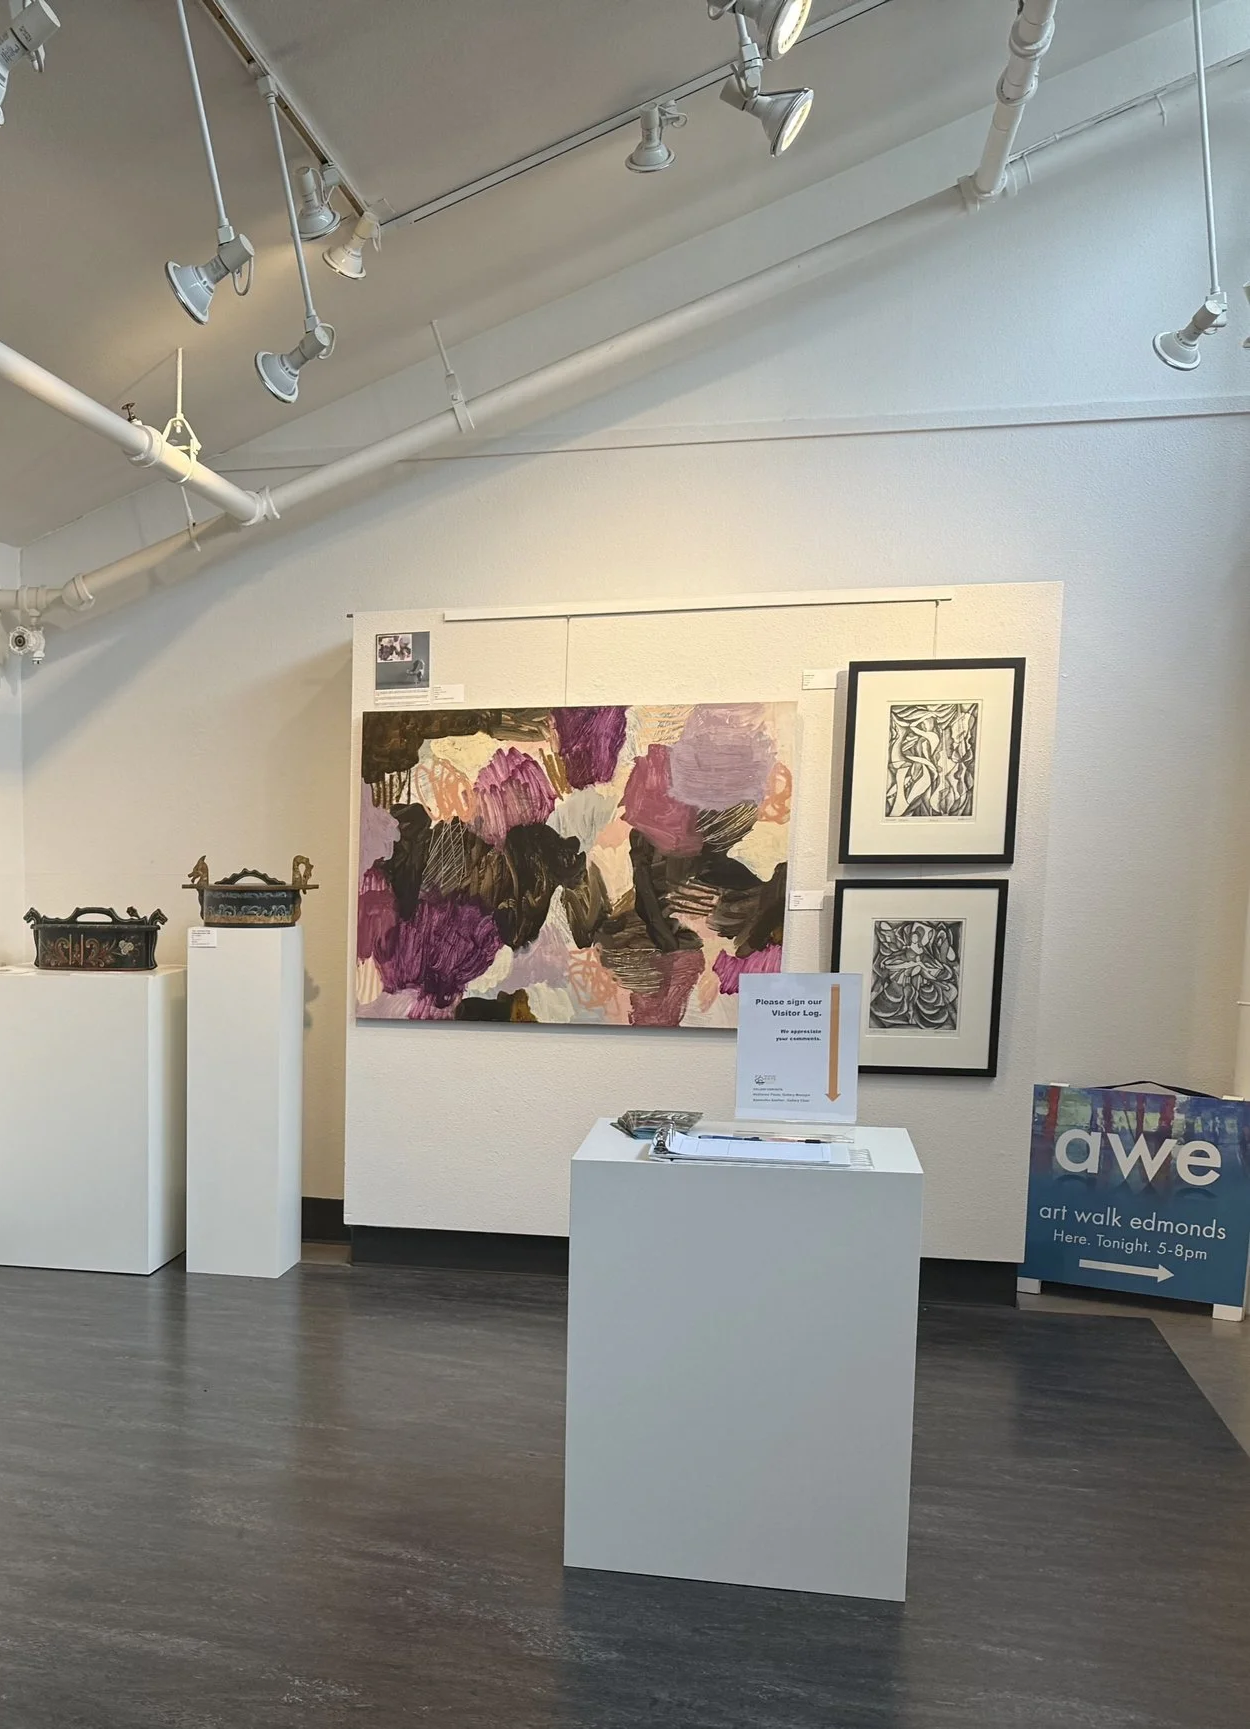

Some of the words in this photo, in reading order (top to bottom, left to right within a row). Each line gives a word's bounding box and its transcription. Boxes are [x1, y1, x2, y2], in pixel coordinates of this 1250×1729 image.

[786, 998, 805, 1006] sign
[803, 1010, 822, 1018] Log.
[1055, 1128, 1222, 1186] awe
[1039, 1205, 1068, 1220] art
[1074, 1207, 1122, 1228] walk
[1130, 1211, 1227, 1240] edmonds
[1053, 1229, 1091, 1246] Here.
[1096, 1234, 1151, 1254] Tonight.
[1157, 1242, 1208, 1261] 5-8pm
